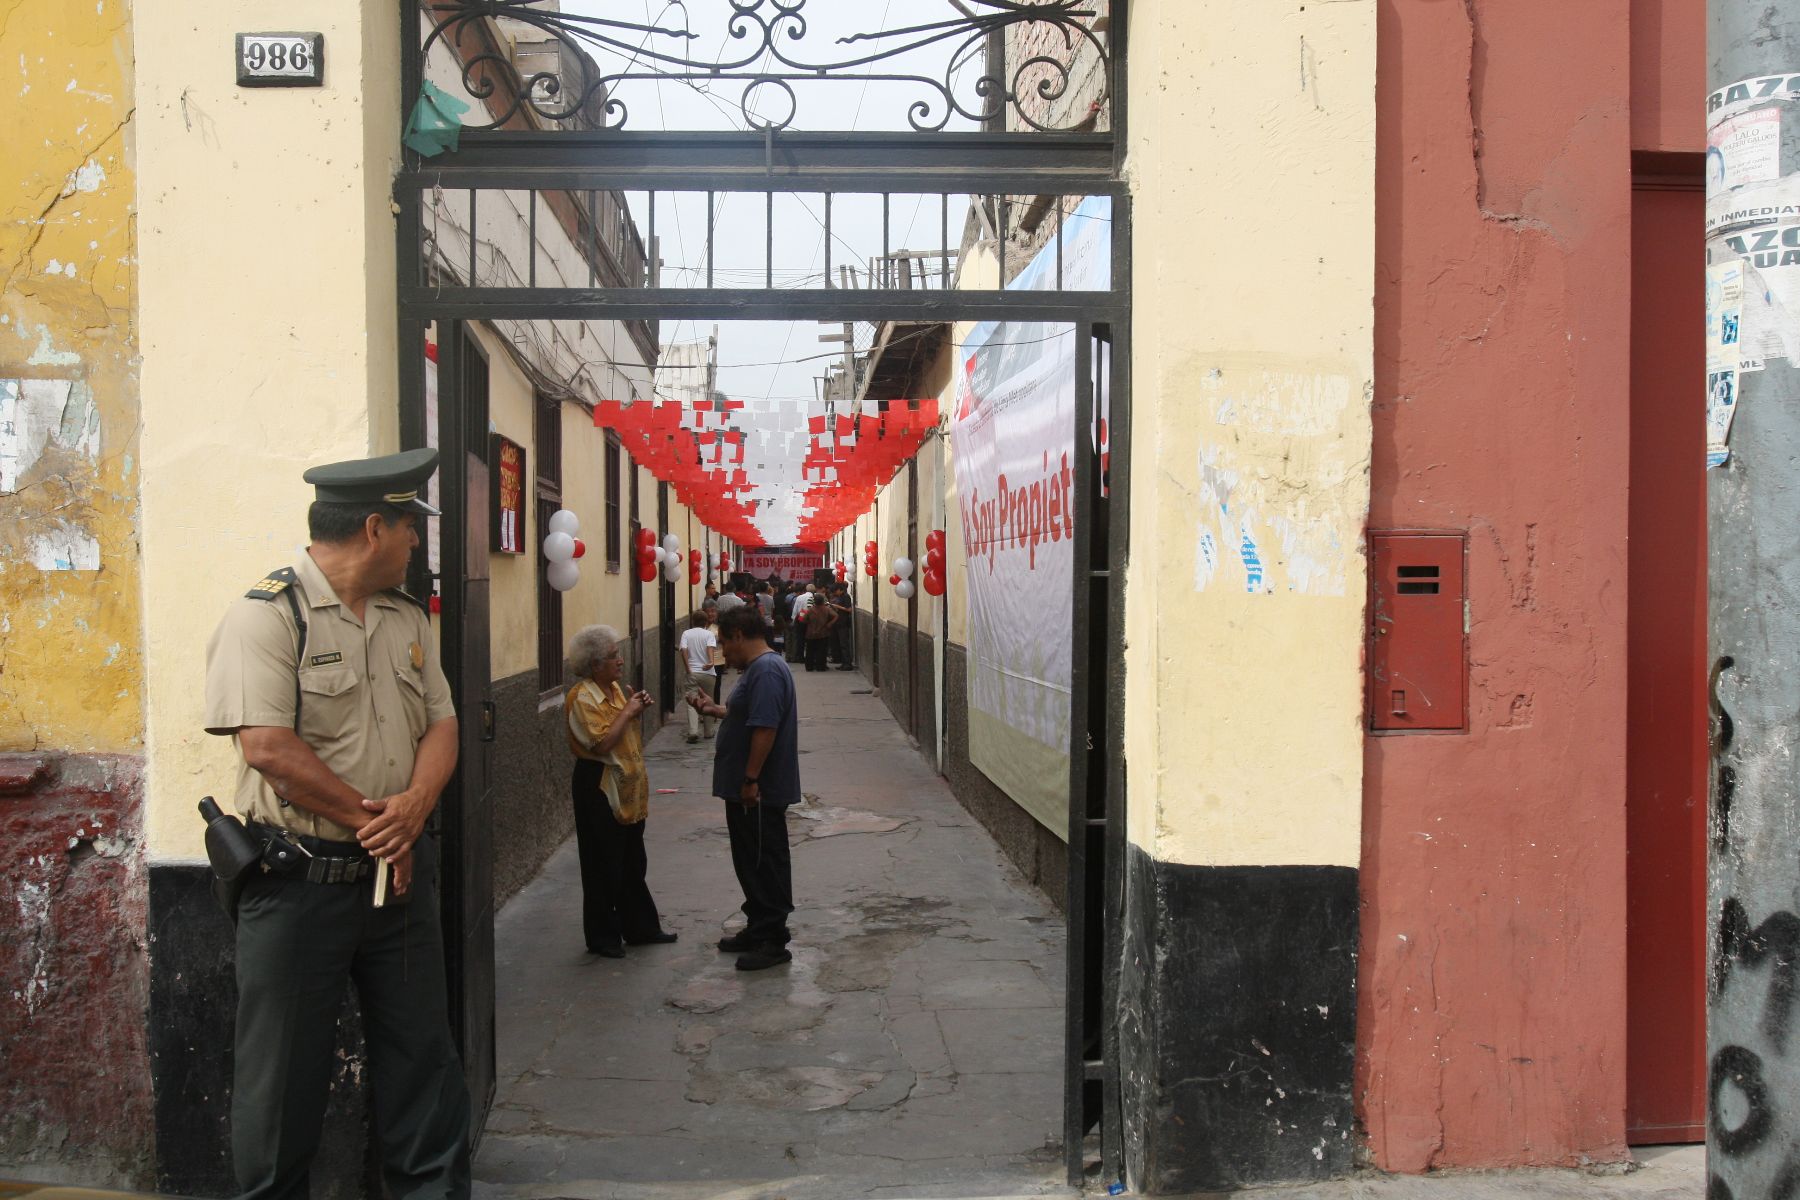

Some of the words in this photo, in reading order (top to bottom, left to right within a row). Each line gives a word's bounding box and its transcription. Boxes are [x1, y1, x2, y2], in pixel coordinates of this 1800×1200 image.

[248, 42, 308, 70] 986
[972, 487, 996, 576] Soy
[998, 450, 1075, 570] Propiet
[744, 557, 755, 568] YA
[755, 557, 775, 568] SOY
